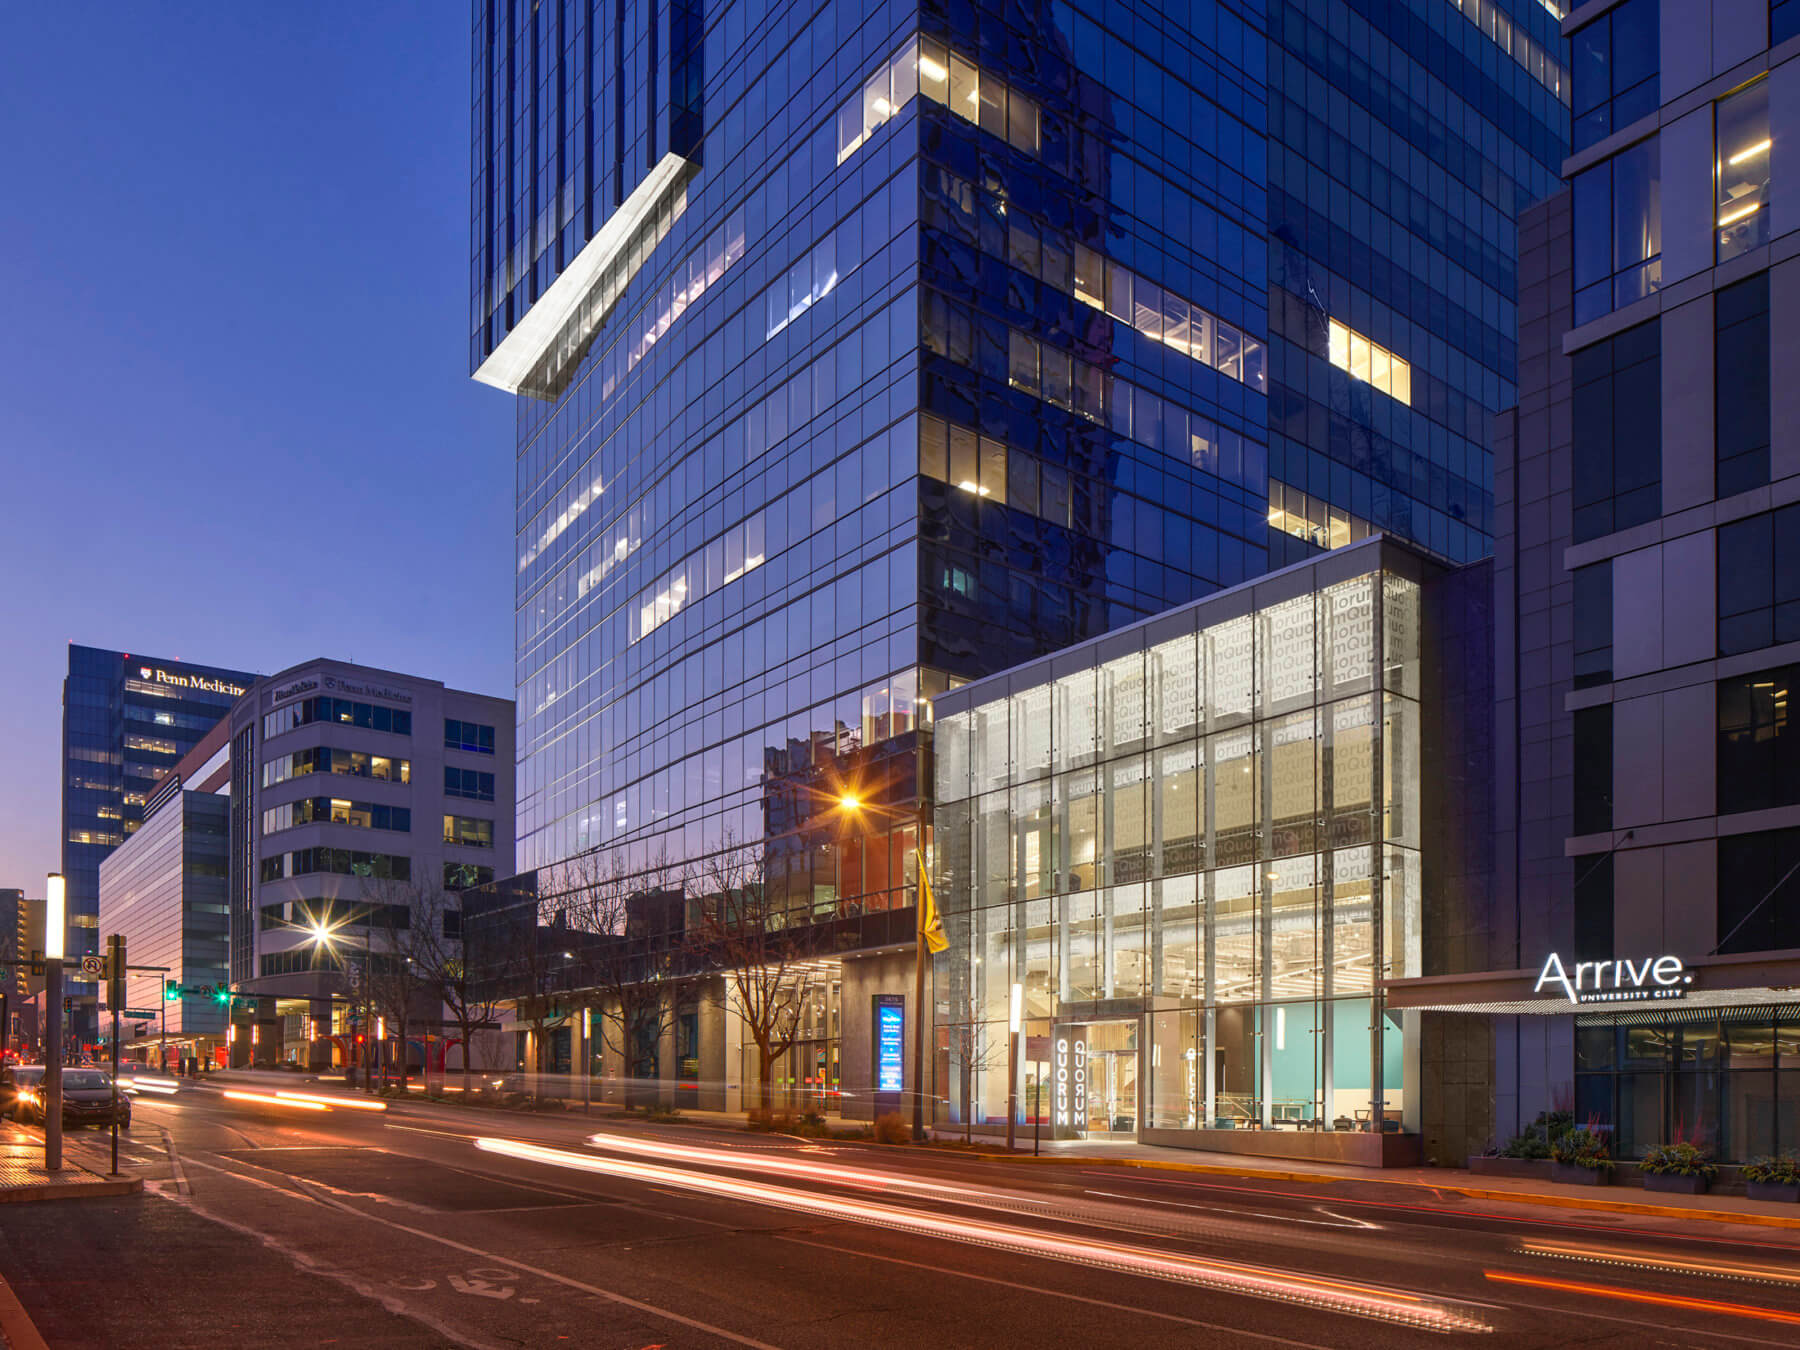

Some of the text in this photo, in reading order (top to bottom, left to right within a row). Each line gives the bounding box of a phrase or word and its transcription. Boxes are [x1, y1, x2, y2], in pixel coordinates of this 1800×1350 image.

[156, 669, 188, 687] Penn
[1580, 988, 1682, 1002] UNIVERSITY CITY
[1056, 1038, 1069, 1126] QUORUM
